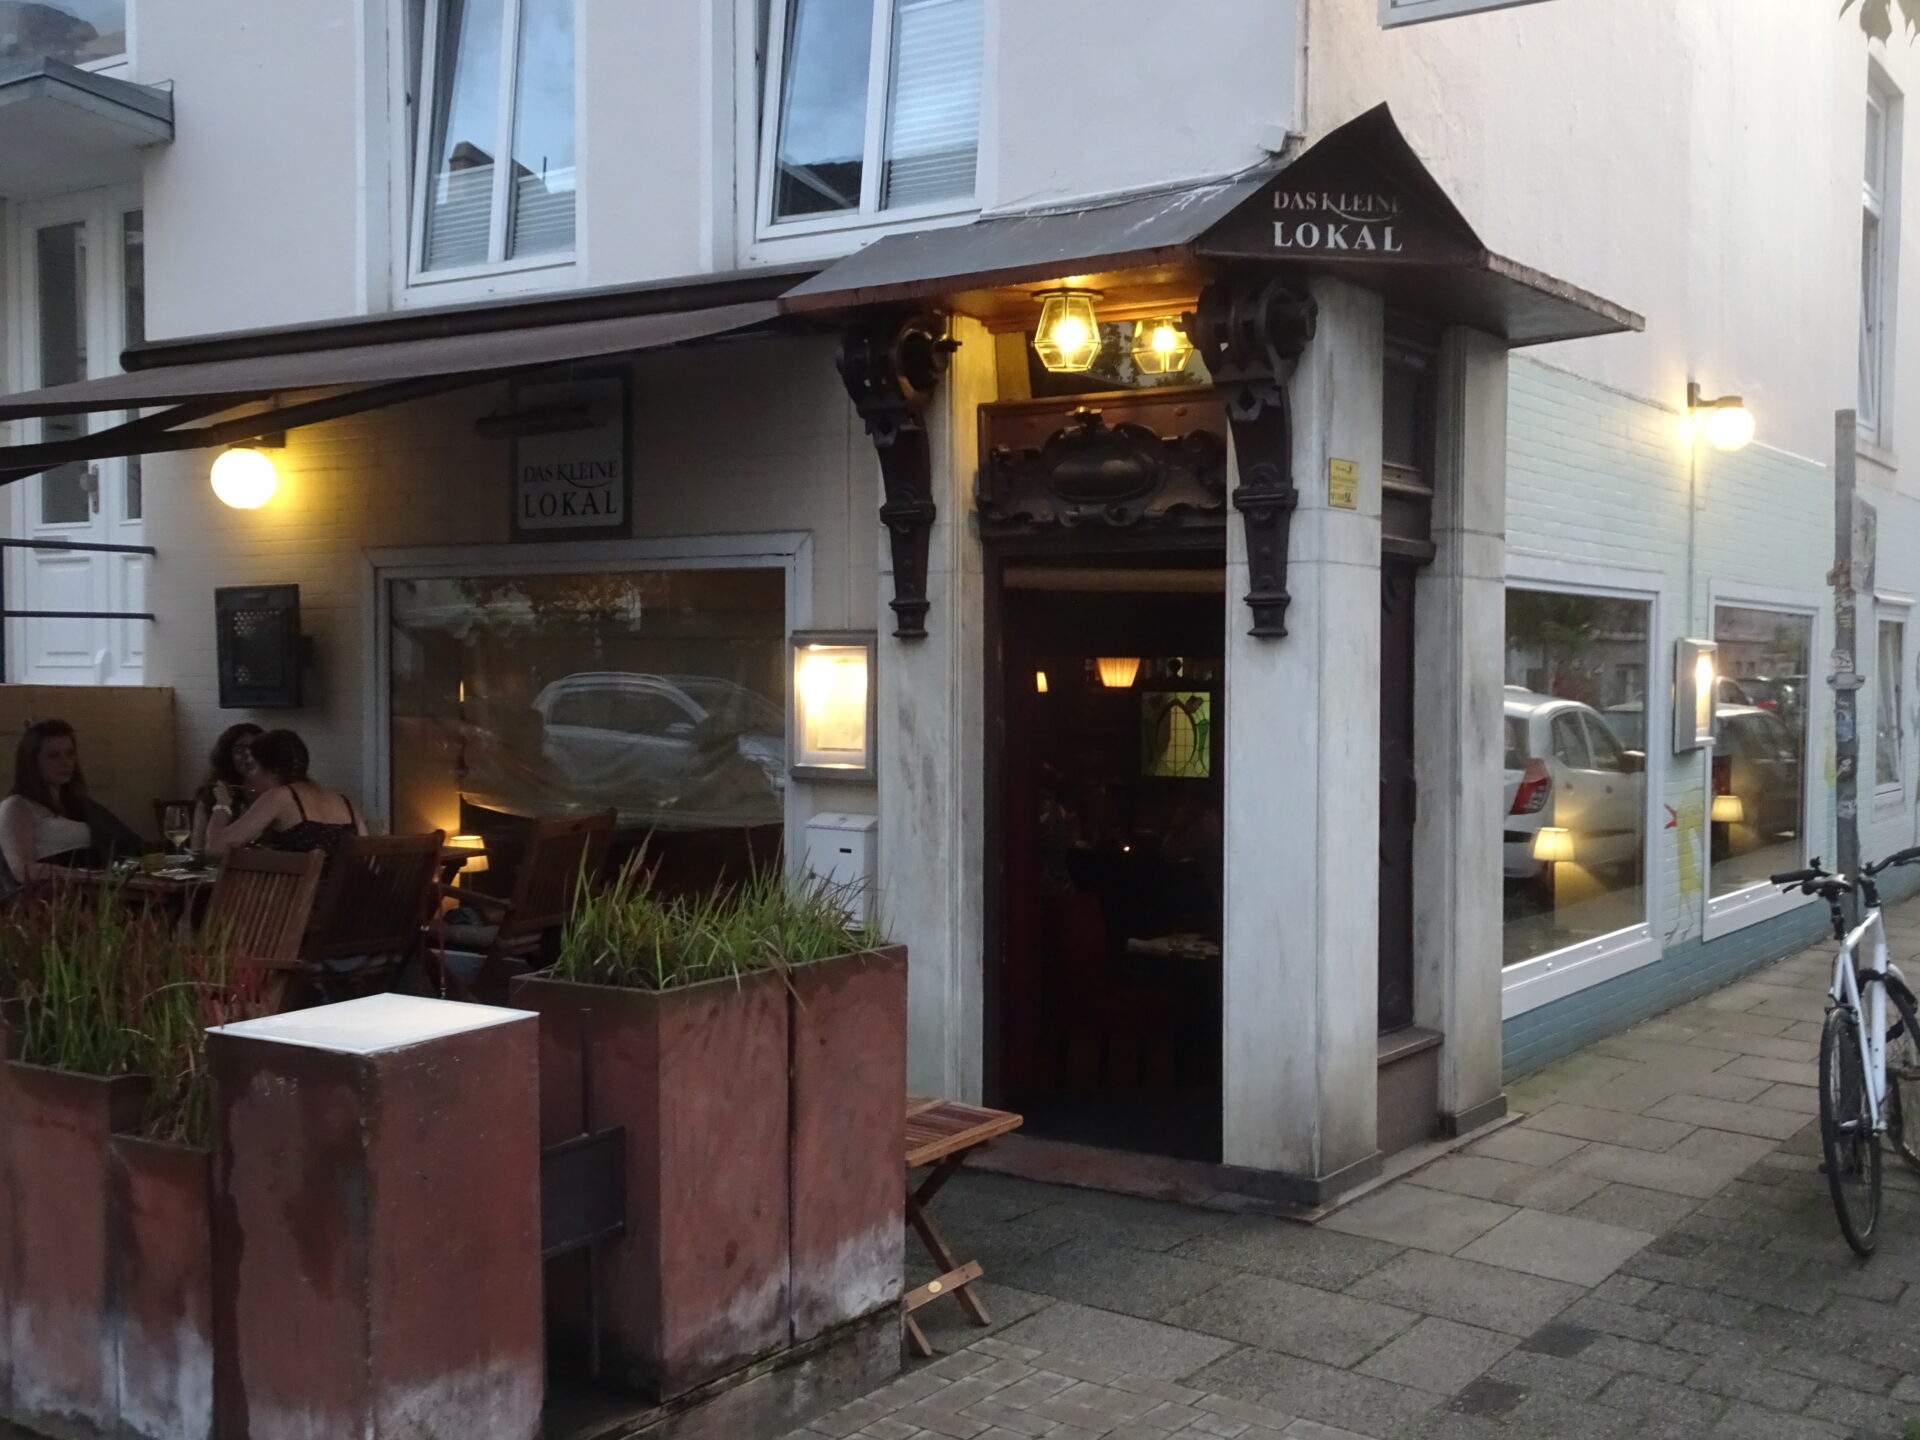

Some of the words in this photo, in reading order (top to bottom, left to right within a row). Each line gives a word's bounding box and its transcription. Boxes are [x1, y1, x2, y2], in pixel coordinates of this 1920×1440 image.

[1273, 191, 1317, 210] DAS
[1272, 221, 1403, 252] LOKAL
[524, 464, 552, 482] DAS
[558, 460, 616, 488] KLEINE
[524, 490, 616, 518] LOKAL
